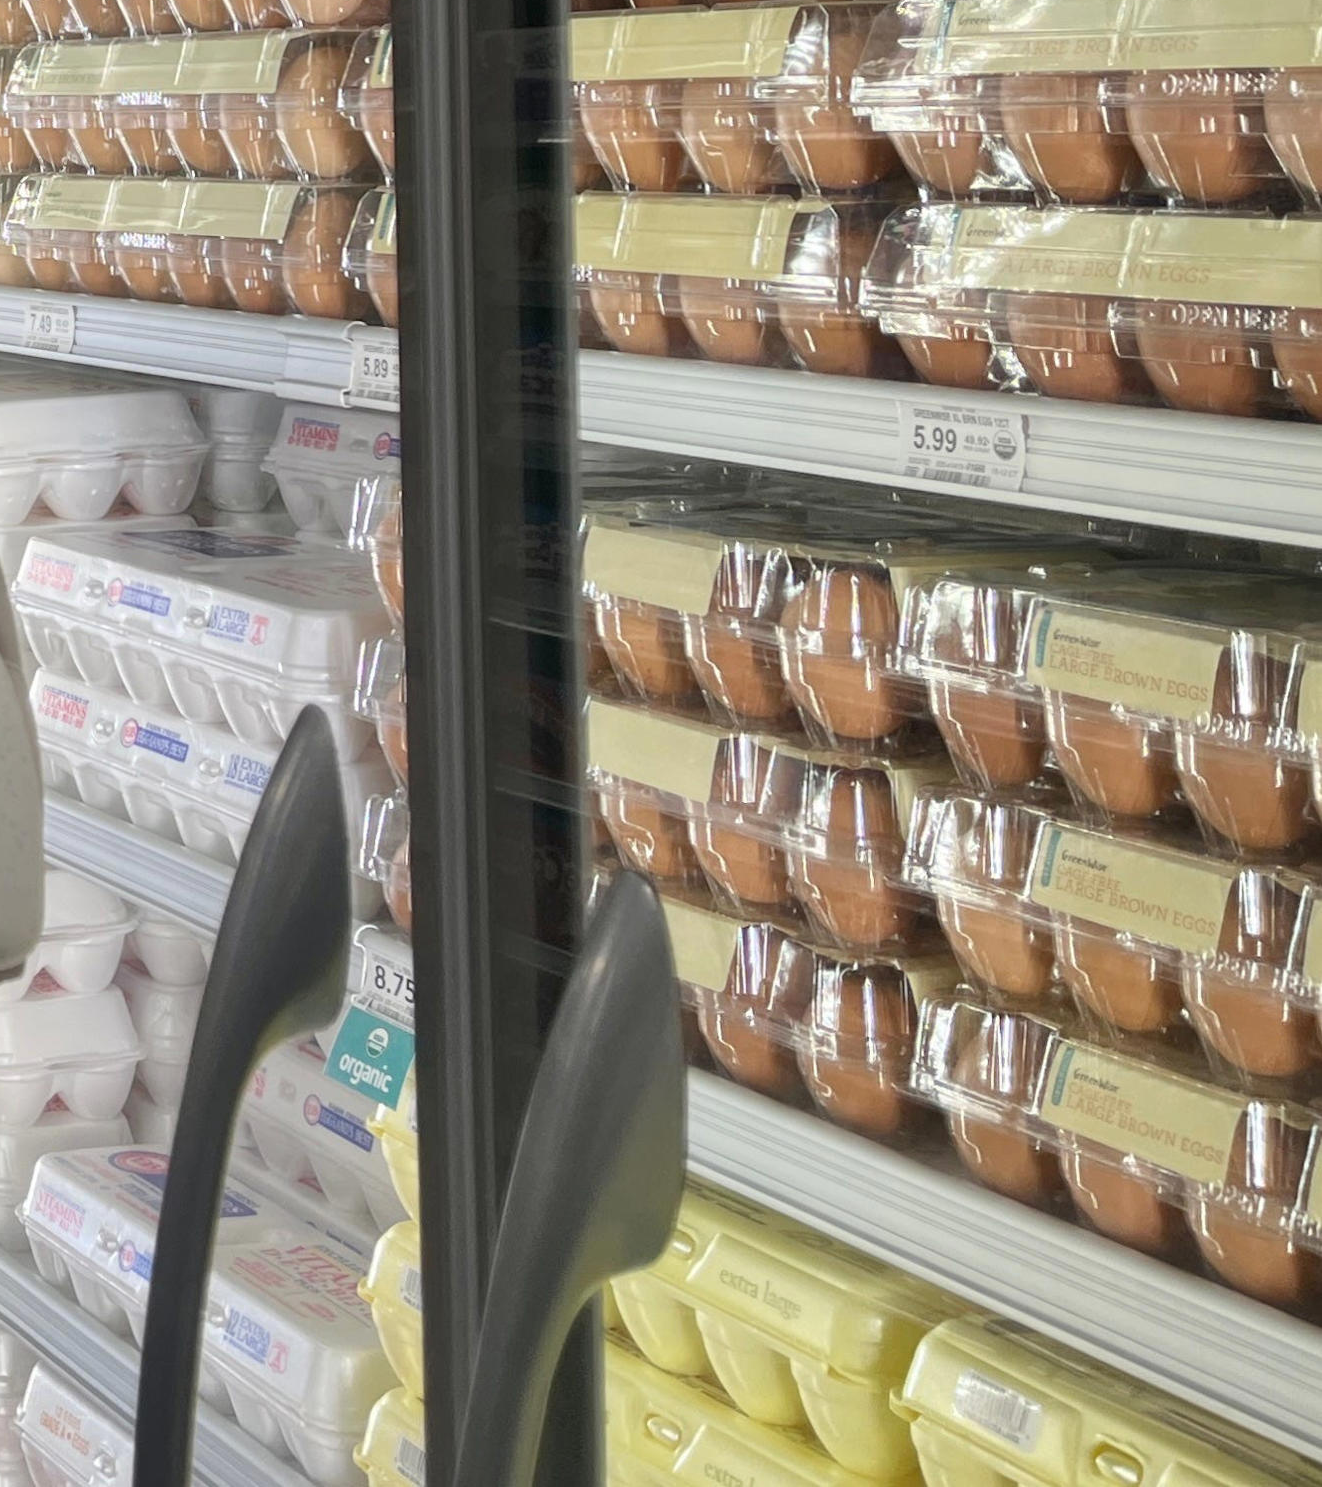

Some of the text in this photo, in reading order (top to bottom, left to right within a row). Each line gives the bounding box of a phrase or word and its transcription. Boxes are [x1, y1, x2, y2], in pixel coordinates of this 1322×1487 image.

[1146, 35, 1199, 54] EGGS
[1018, 256, 1076, 276] LARGE
[1157, 263, 1212, 284] EGGS
[30, 313, 52, 333] 7.49
[363, 357, 389, 378] 5.89
[913, 424, 958, 453] 5.99
[220, 605, 251, 623] EXTRA
[217, 620, 247, 638] LARGE
[1048, 654, 1209, 703] LARGE BROWN EGGS
[41, 688, 89, 719] VITAMINS
[1054, 875, 1217, 937] LARGE BROWN EGGS
[374, 964, 416, 1004] 8.75
[339, 1053, 394, 1094] organic
[1065, 1093, 1225, 1165] LARGE BROWN EGGS
[719, 1267, 803, 1321] extra large
[239, 1315, 271, 1344] EXTRA
